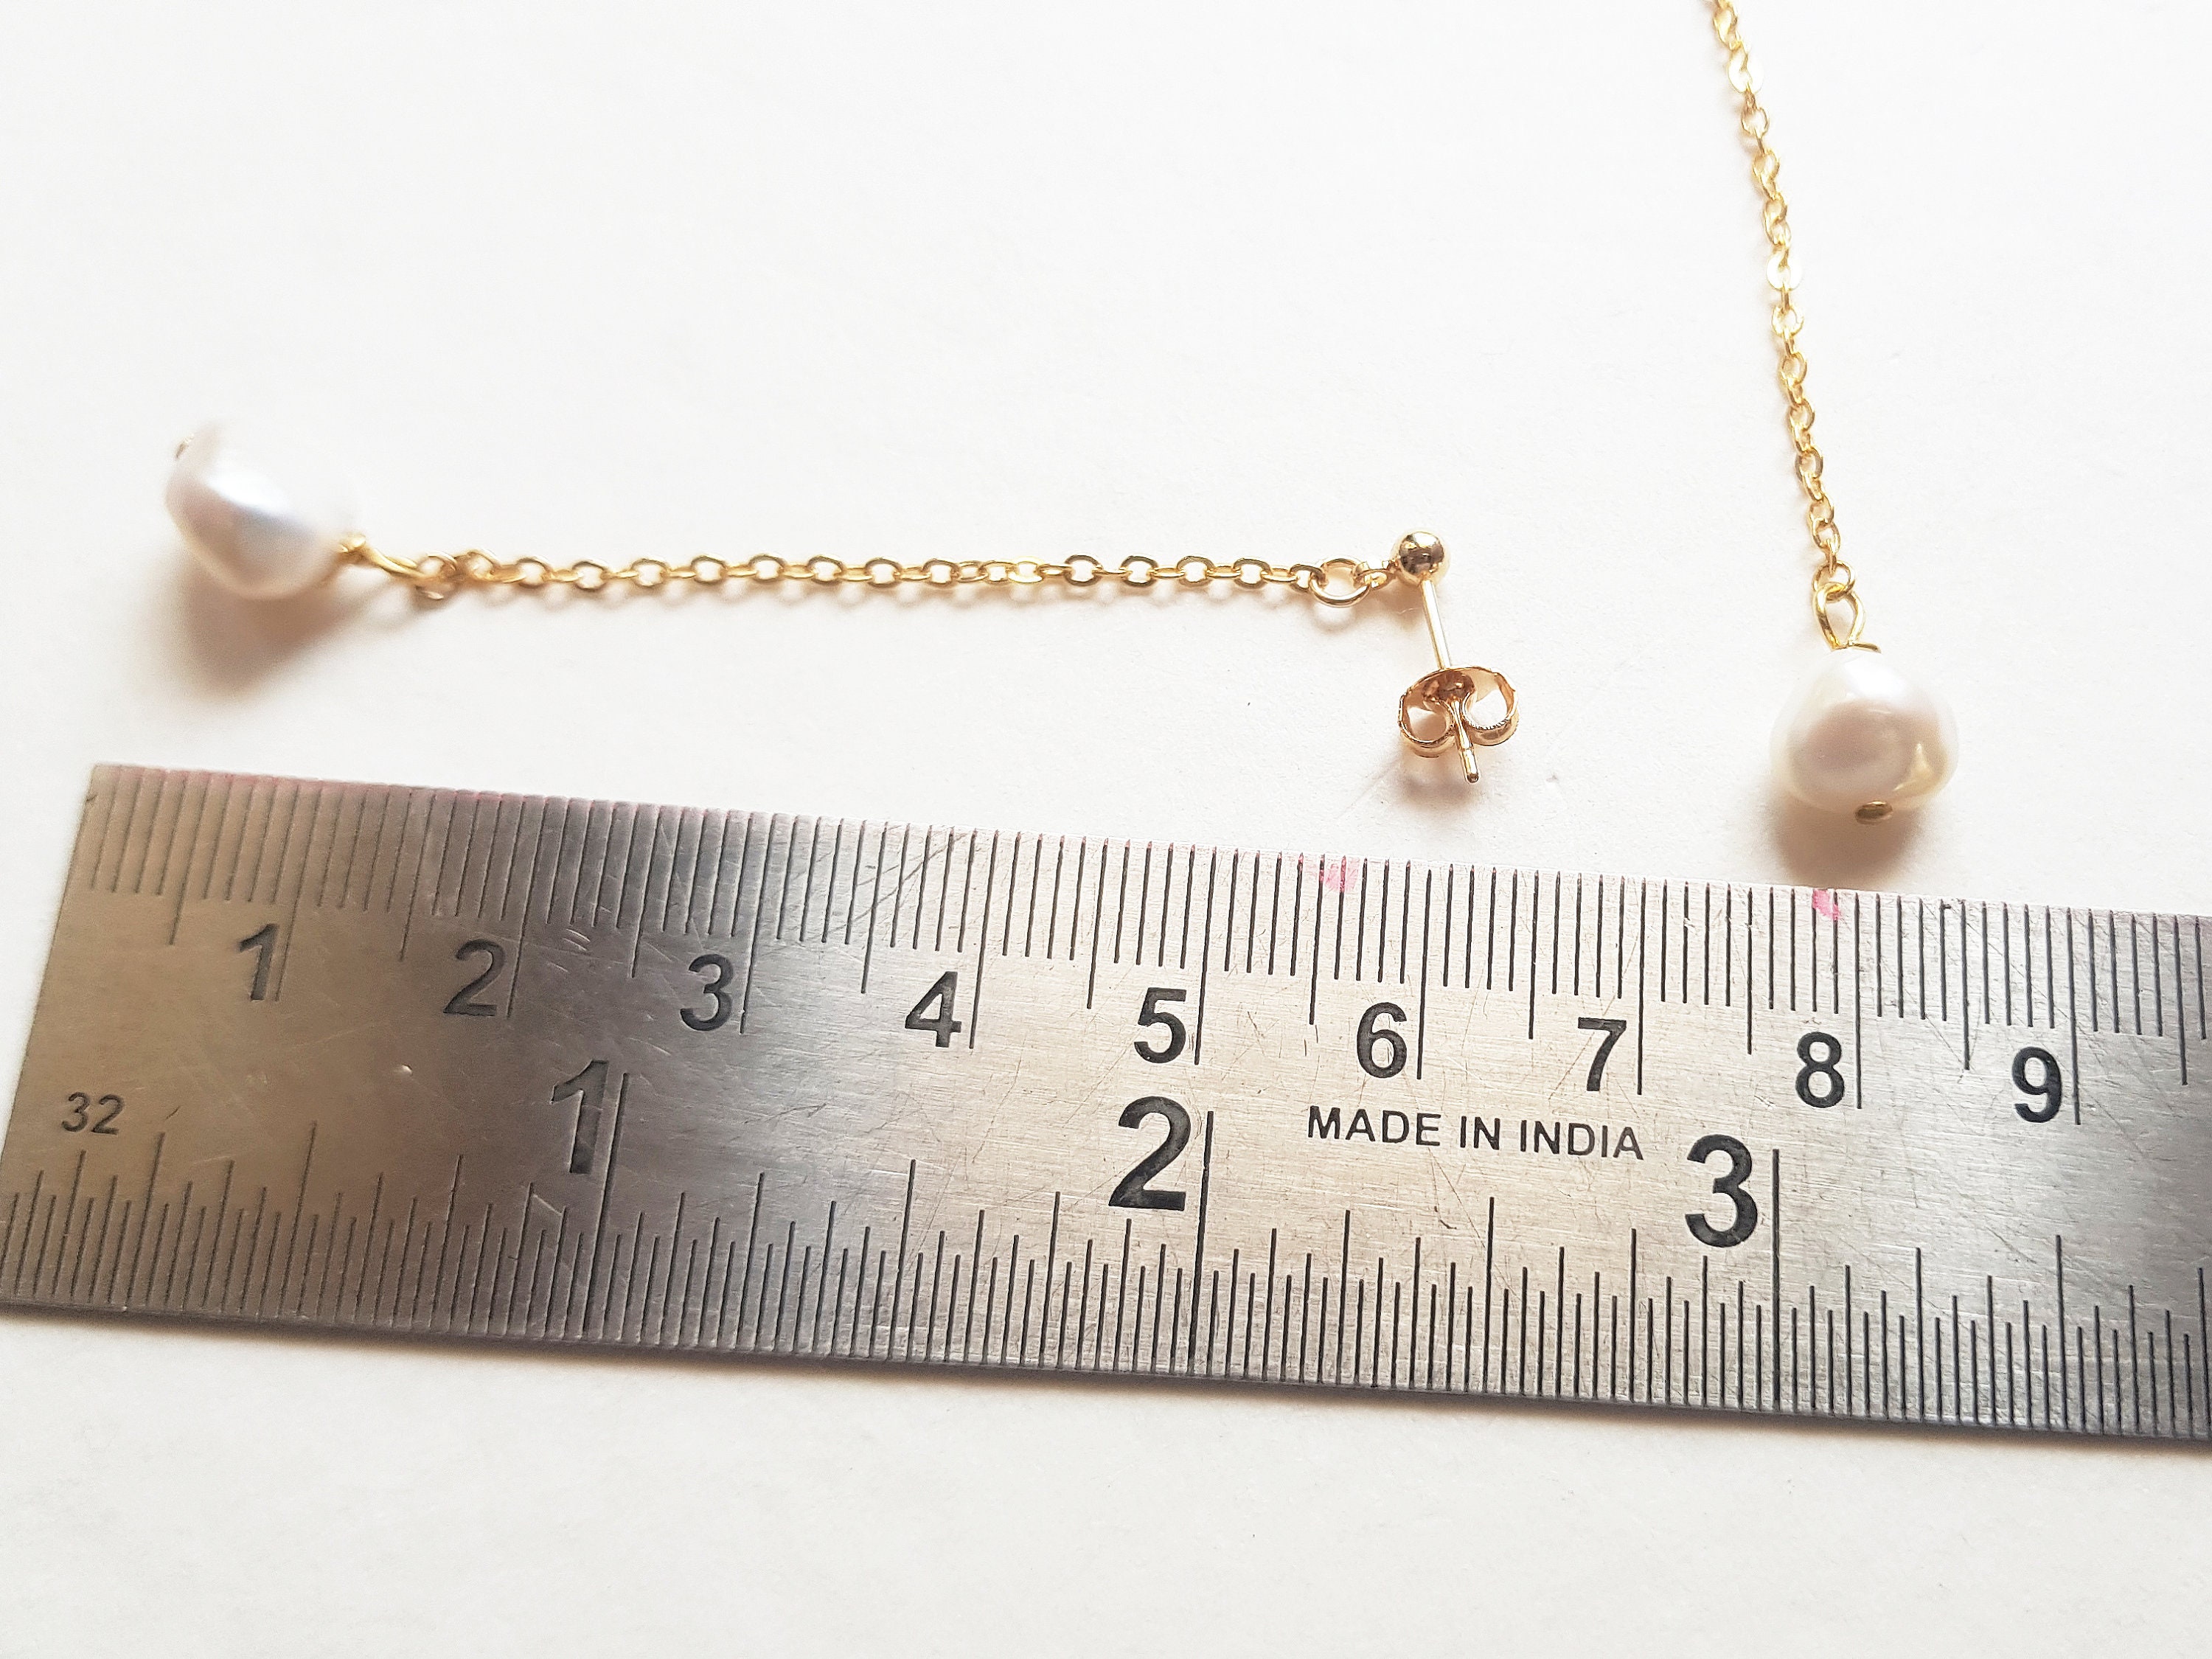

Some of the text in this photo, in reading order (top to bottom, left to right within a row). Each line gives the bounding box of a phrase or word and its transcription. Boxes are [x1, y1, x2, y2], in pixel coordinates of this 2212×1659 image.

[238, 923, 2062, 1123] 1 2 3 4 5 6 7 8 9
[60, 1092, 125, 1135] 32
[550, 1060, 1758, 1248] 1 2 3
[1308, 1105, 1644, 1161] MADE IN INDIA
